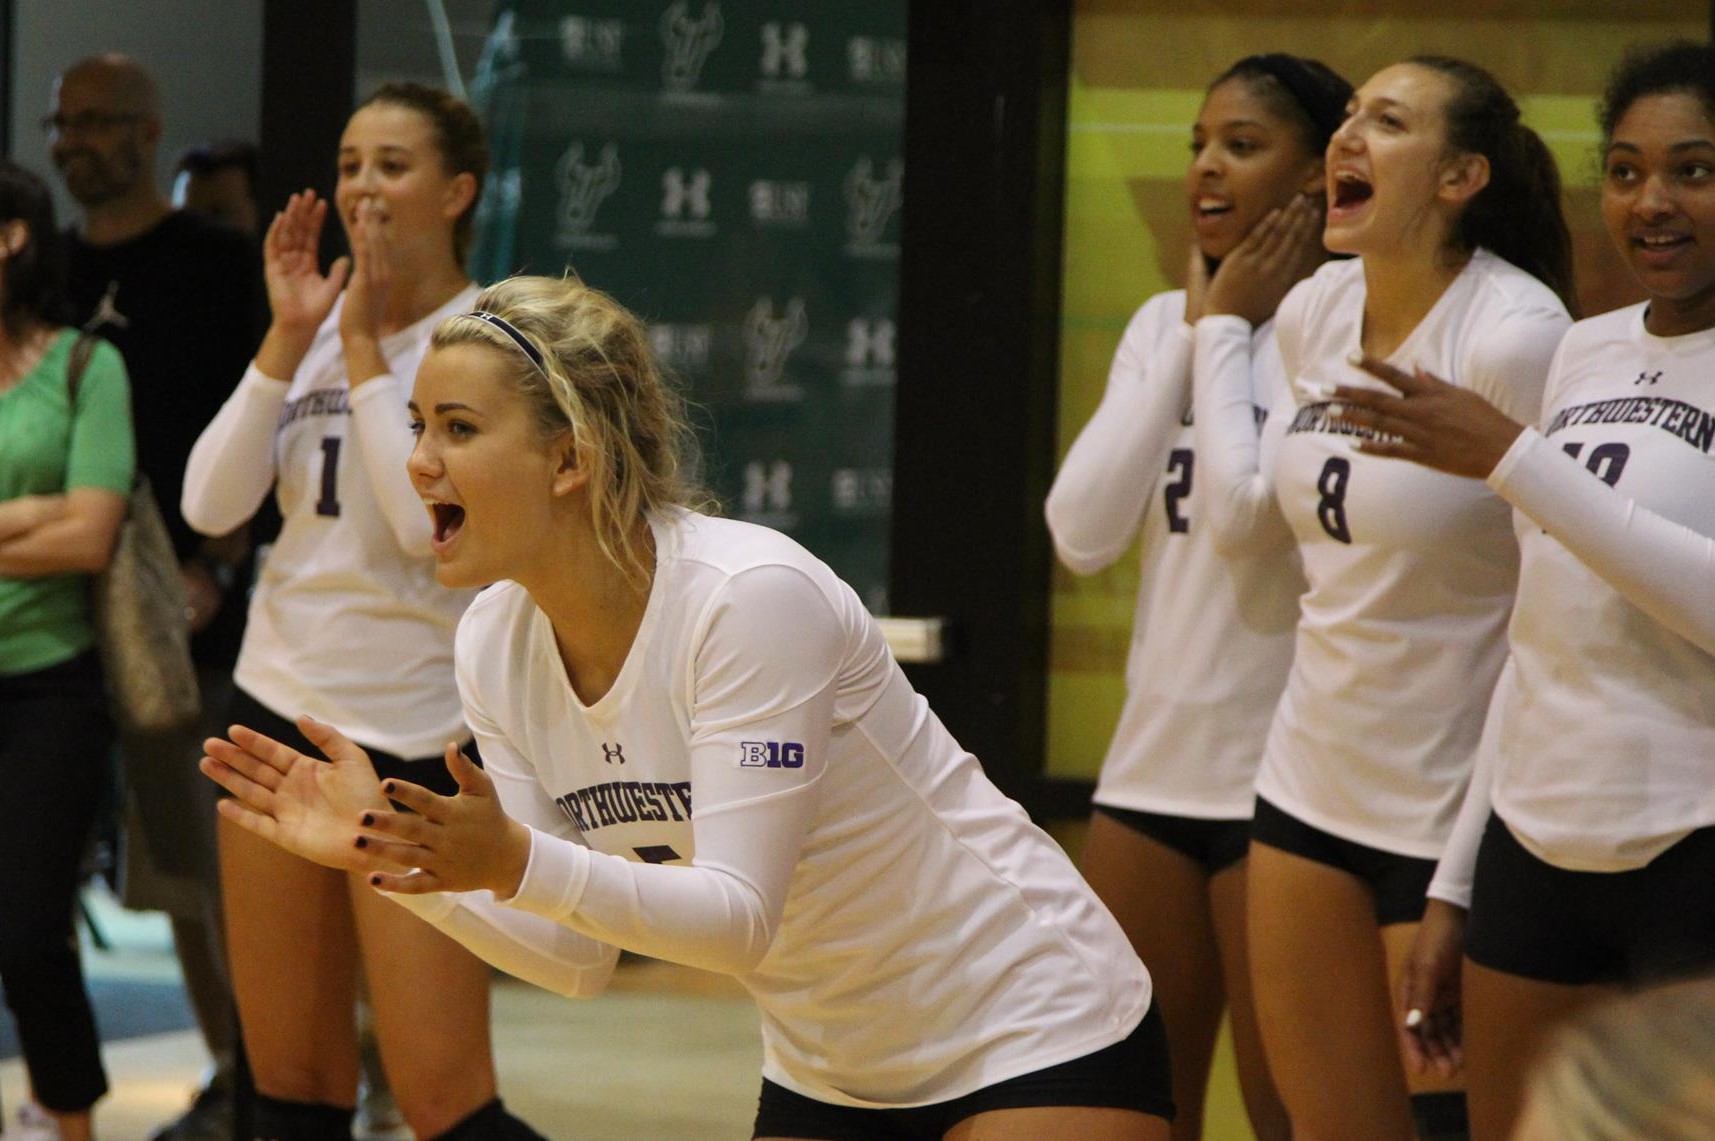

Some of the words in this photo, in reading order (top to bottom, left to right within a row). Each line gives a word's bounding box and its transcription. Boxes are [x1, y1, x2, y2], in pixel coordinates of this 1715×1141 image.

[316, 437, 341, 517] 1
[1165, 449, 1193, 533] 2
[1318, 457, 1351, 544] 8
